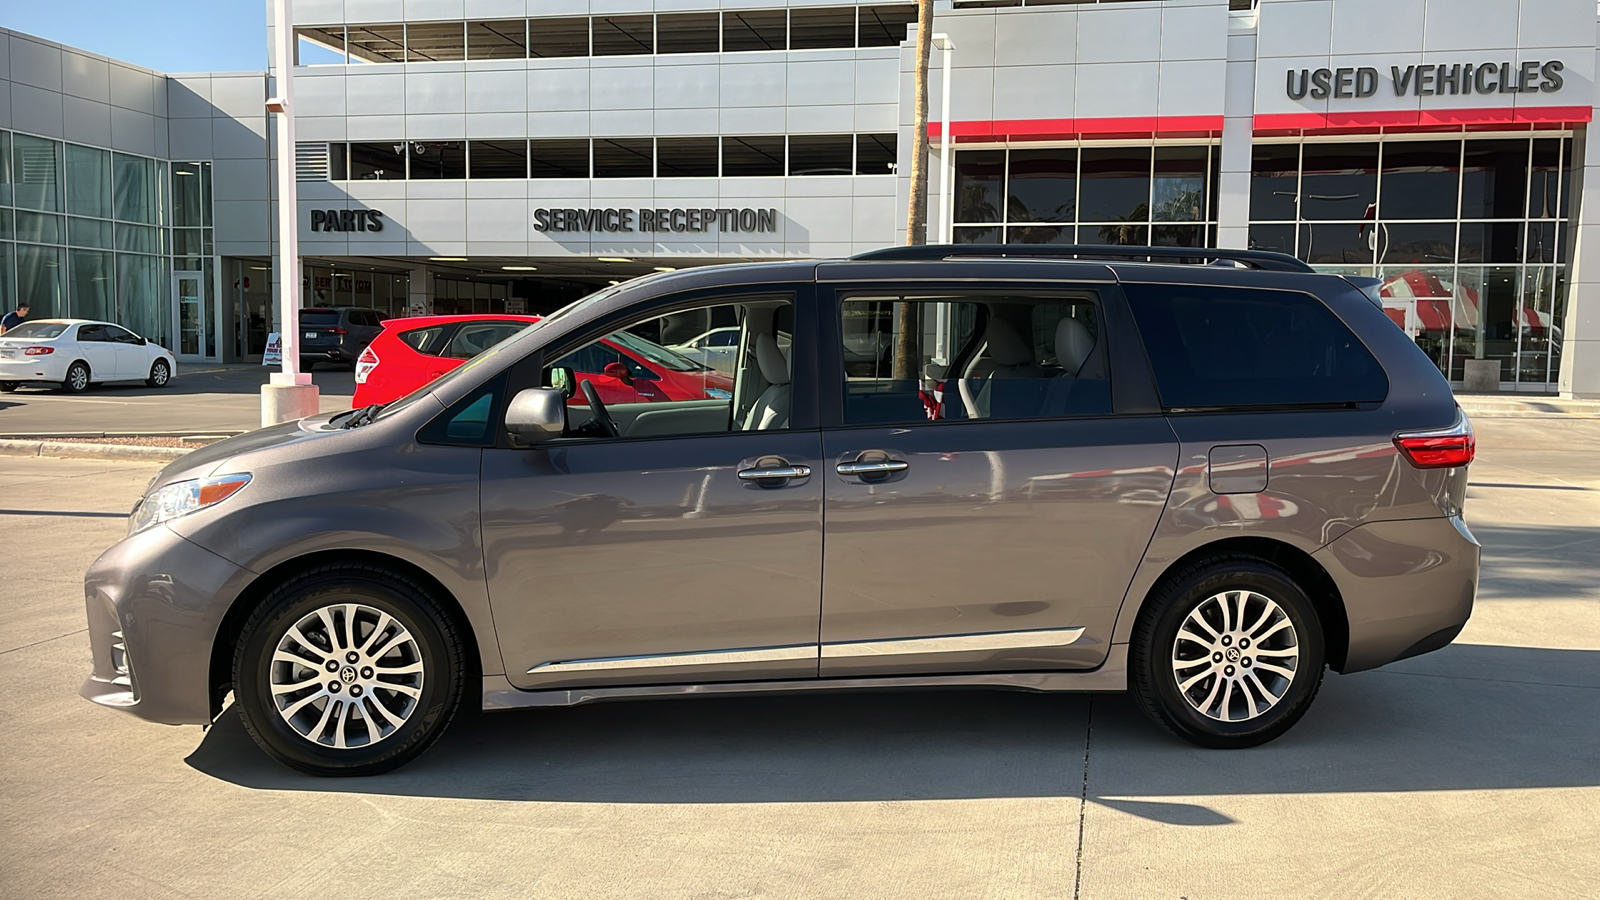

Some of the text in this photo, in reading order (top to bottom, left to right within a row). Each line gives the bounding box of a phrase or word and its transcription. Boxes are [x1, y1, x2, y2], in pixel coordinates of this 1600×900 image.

[1286, 61, 1564, 100] USED VEHICLES
[311, 209, 383, 232] PARTS
[533, 208, 776, 232] SERVICE RECEPTION
[303, 275, 334, 288] DSER
